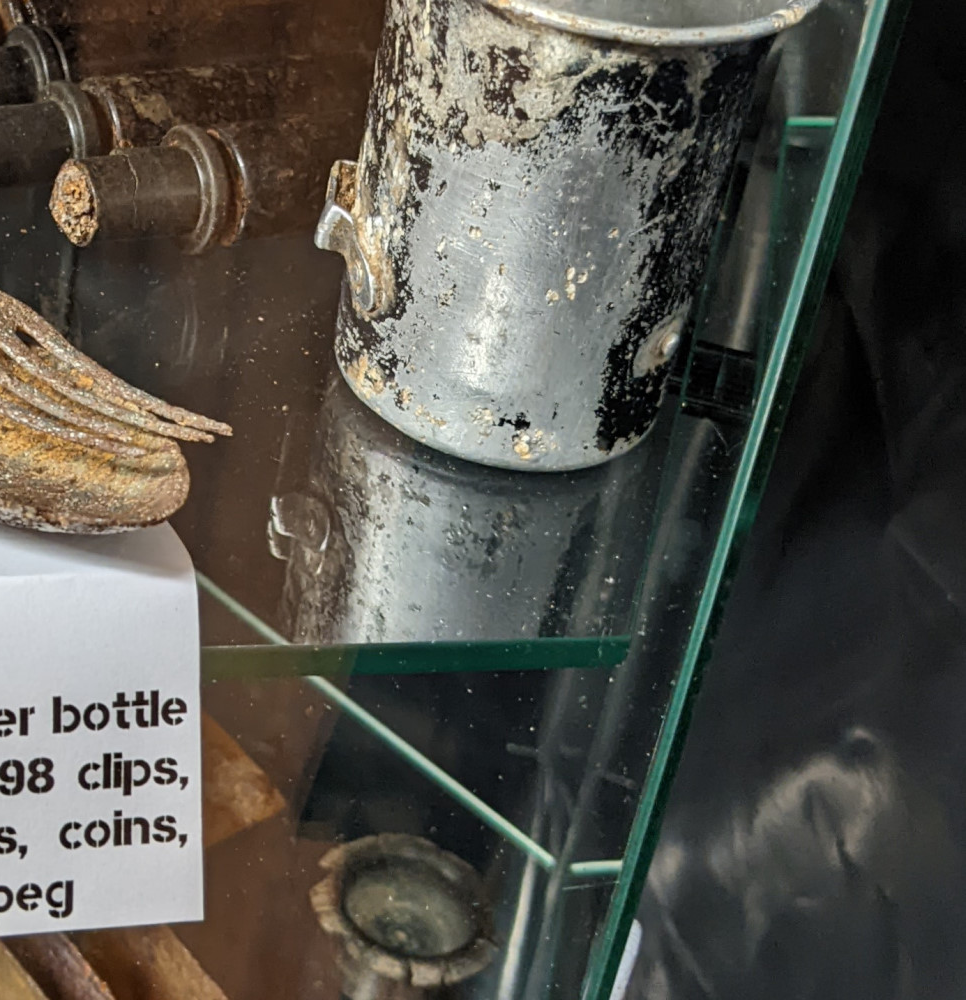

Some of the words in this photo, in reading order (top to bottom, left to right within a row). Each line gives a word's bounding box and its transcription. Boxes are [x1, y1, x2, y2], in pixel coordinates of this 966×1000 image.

[53, 690, 186, 733] bottle
[78, 753, 188, 796] clips,
[59, 811, 187, 849] coins,
